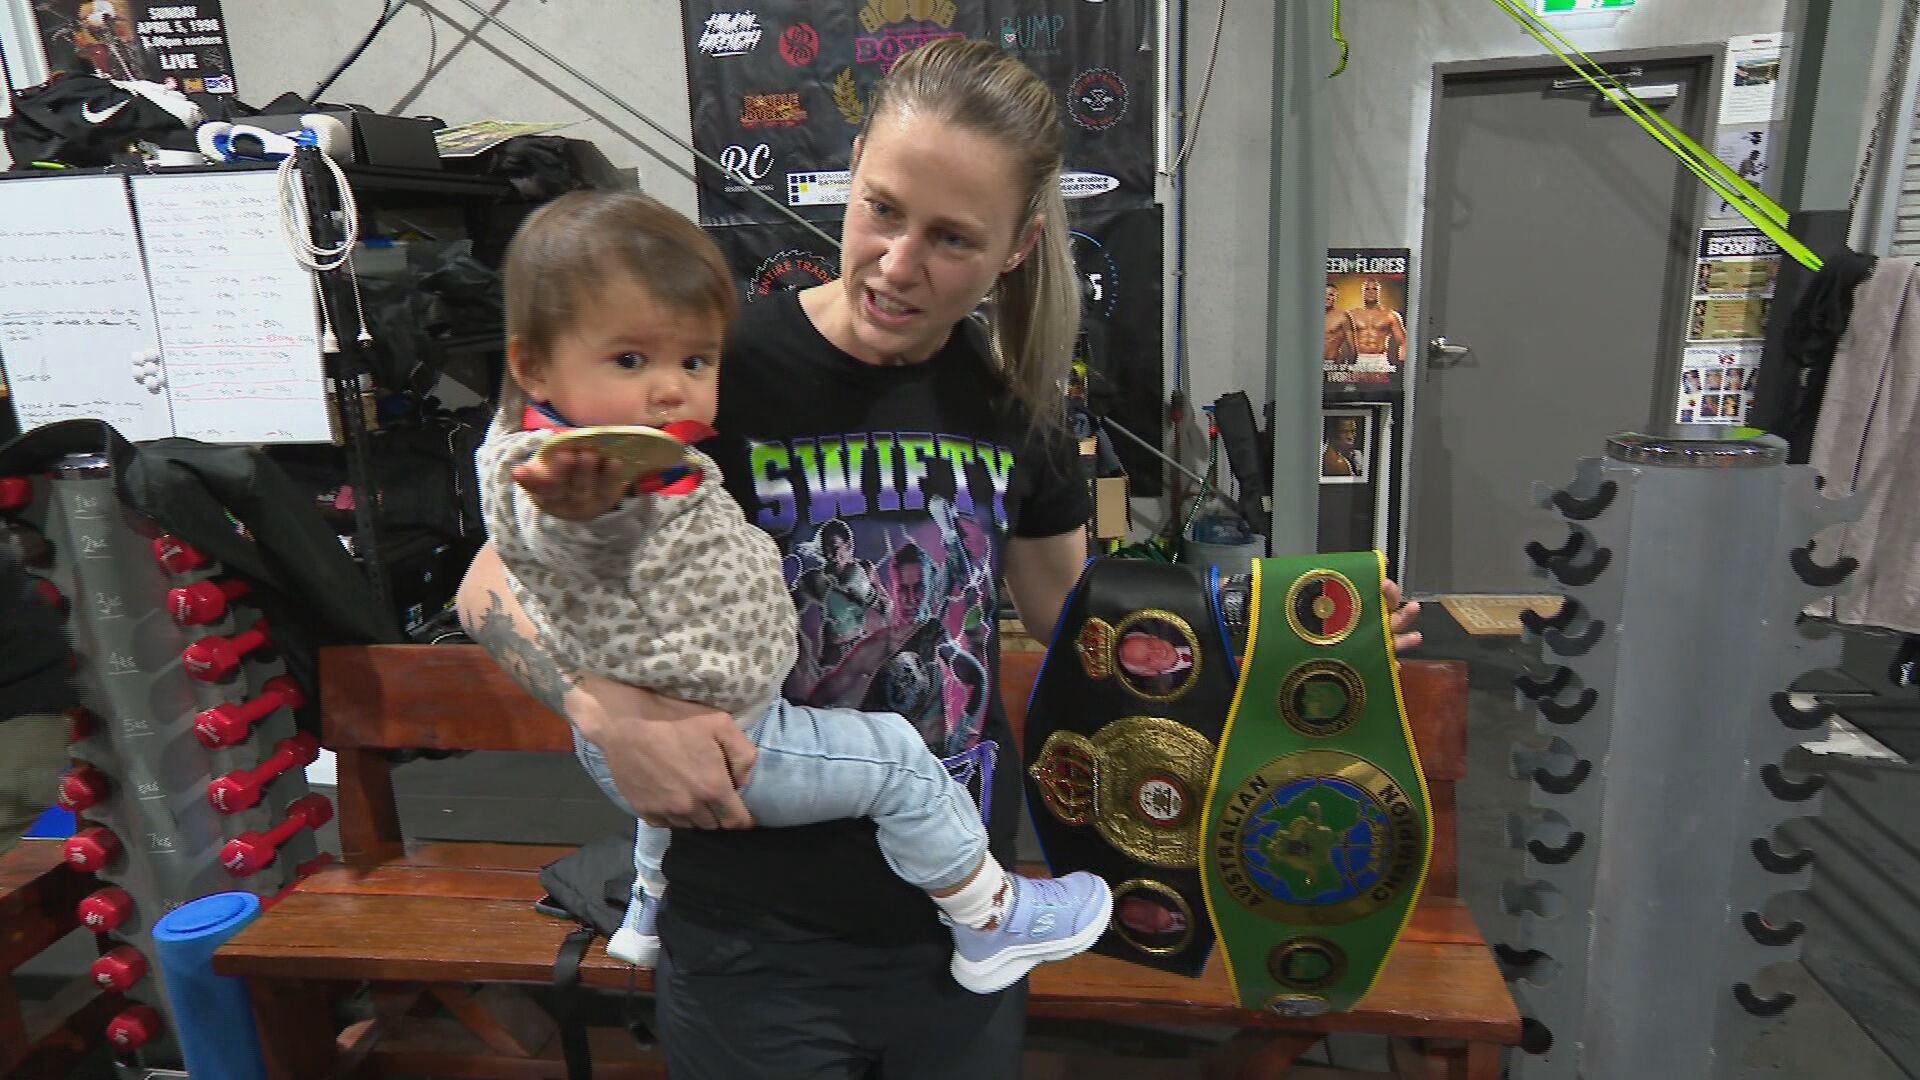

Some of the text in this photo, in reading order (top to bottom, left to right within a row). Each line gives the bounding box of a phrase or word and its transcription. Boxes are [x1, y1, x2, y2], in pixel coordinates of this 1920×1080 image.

[148, 6, 197, 20] SUNDAY
[137, 18, 220, 34] APRIL 5, 1998
[184, 35, 222, 46] eastern
[160, 53, 198, 70] LIVE
[744, 93, 800, 108] DOUBLE
[720, 143, 775, 185] RC
[1707, 241, 1777, 255] BOXING
[1356, 257, 1406, 273] FLORES
[758, 259, 792, 297] ENTIRE
[1718, 353, 1735, 365] VS
[749, 431, 1015, 537] SWIFTY
[1216, 775, 1269, 907] AUSTRALIAN
[1371, 783, 1416, 903] CHAMPION
